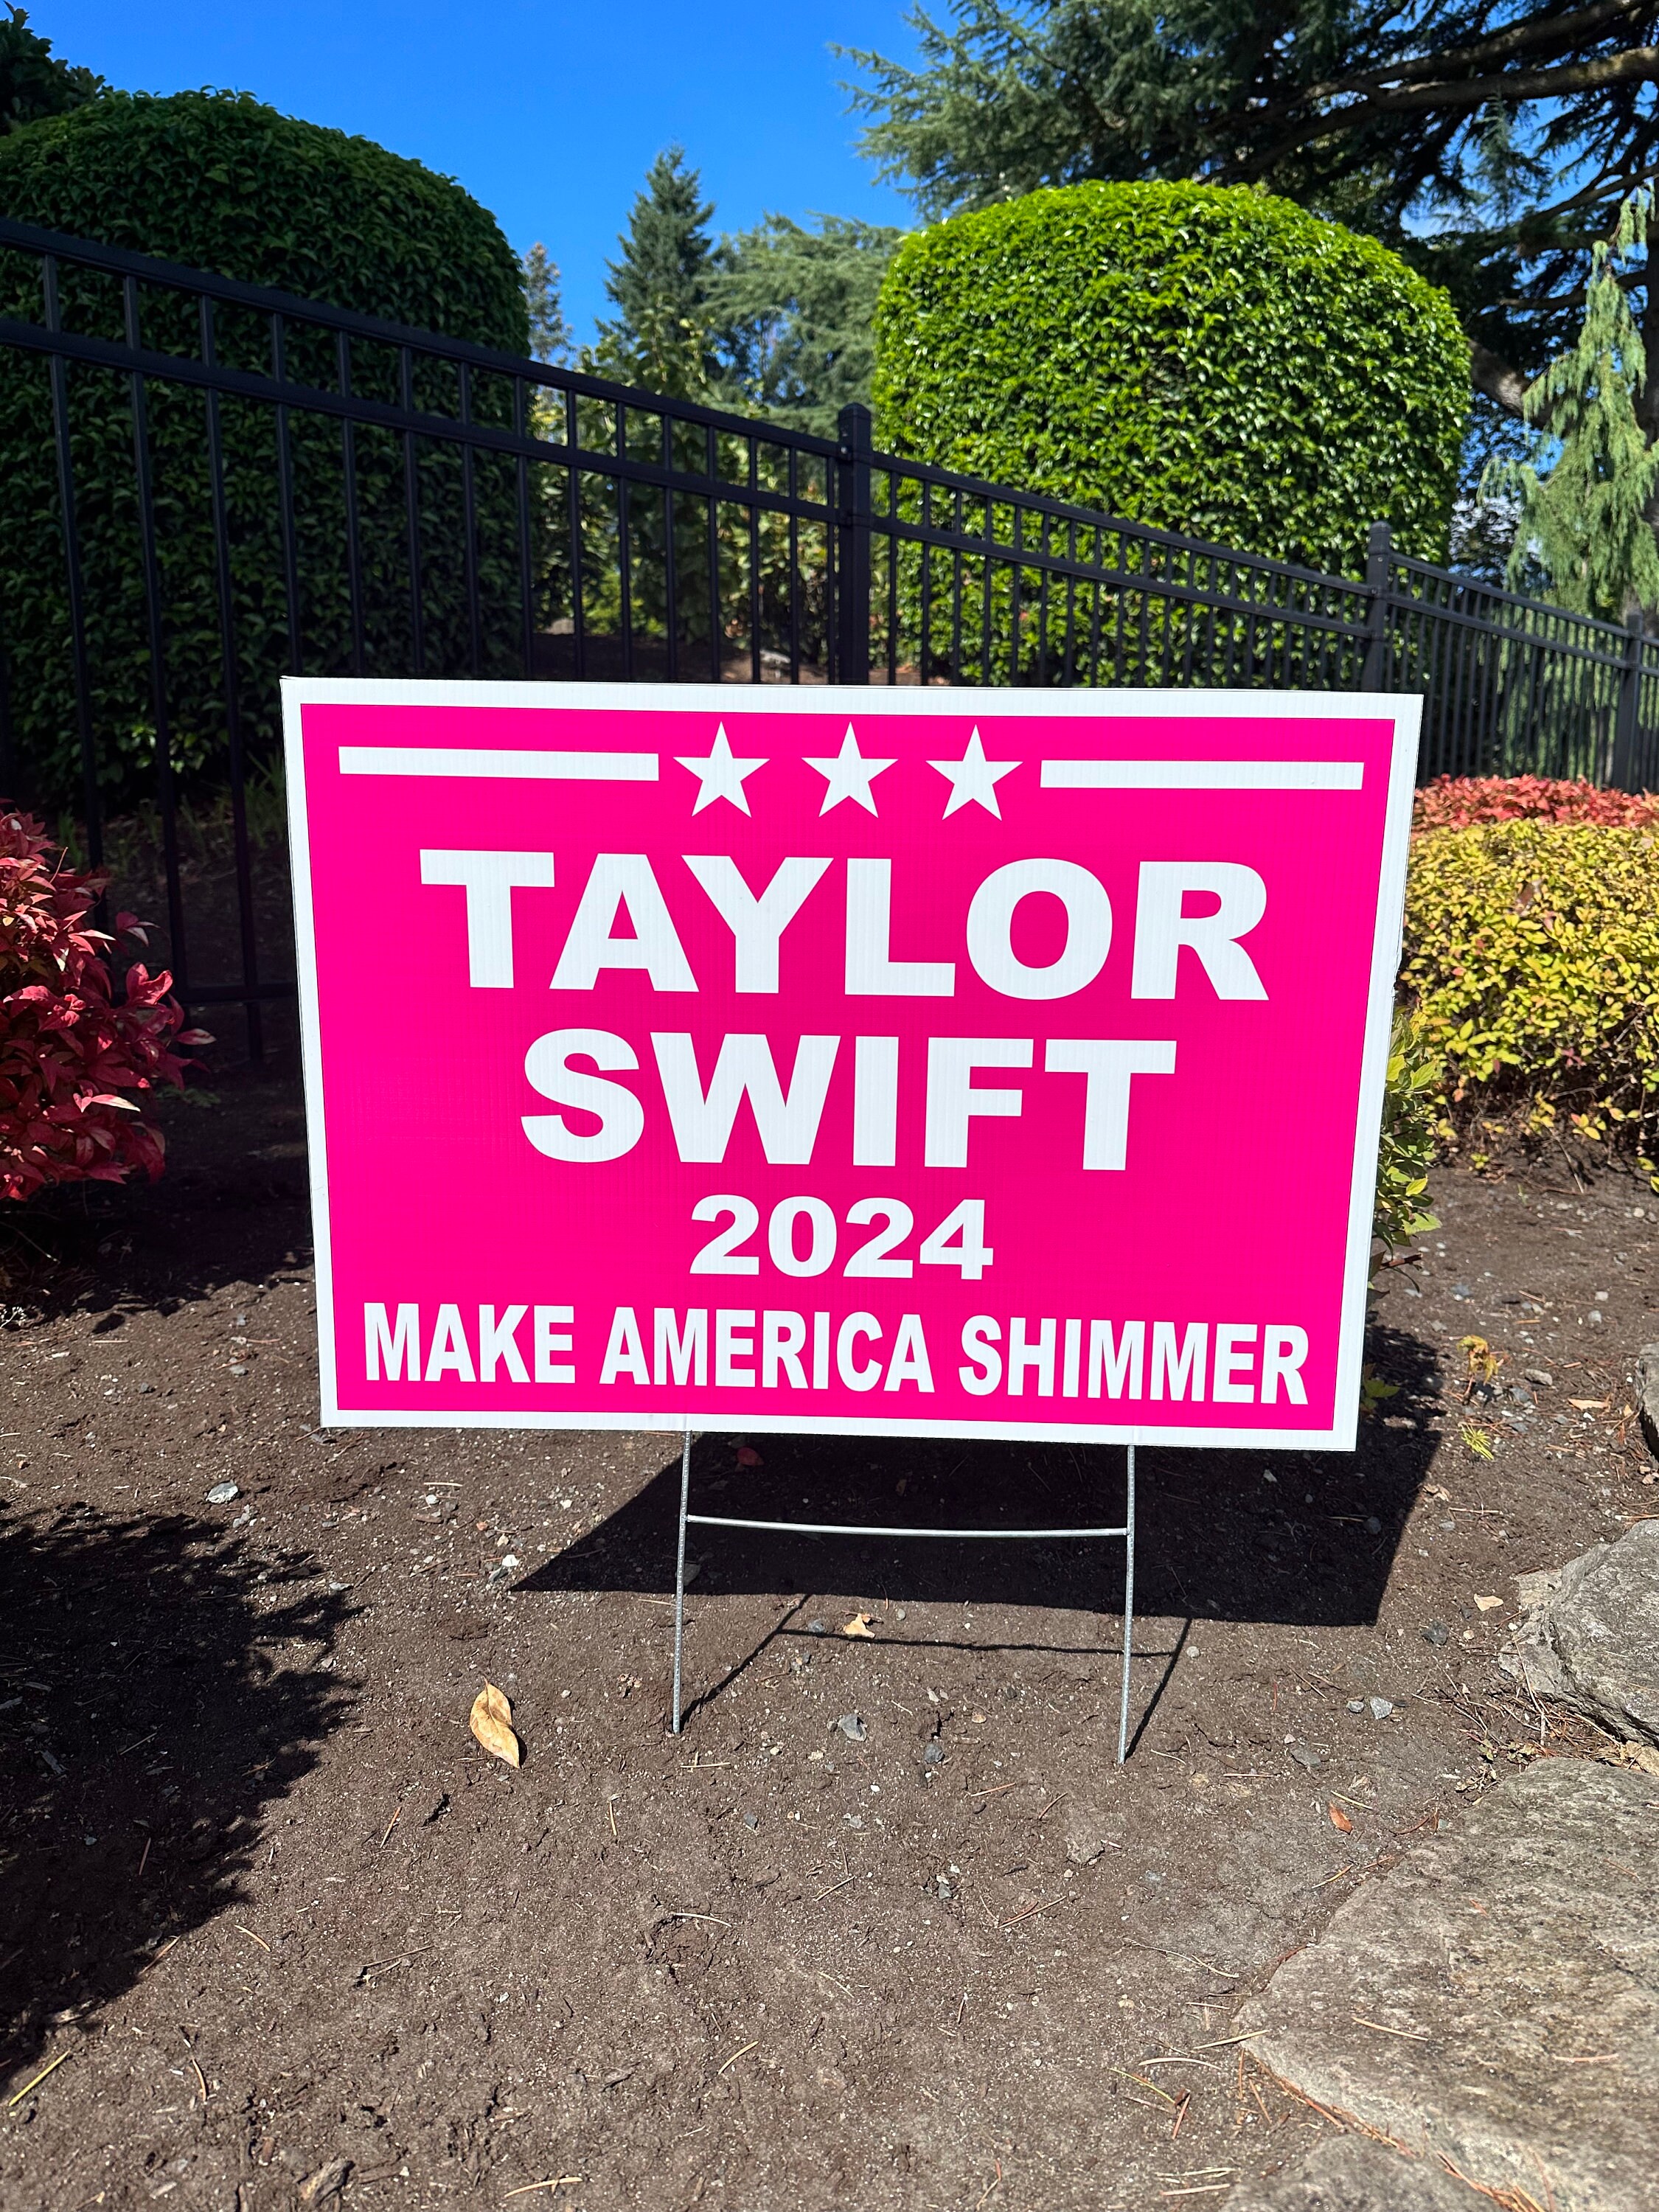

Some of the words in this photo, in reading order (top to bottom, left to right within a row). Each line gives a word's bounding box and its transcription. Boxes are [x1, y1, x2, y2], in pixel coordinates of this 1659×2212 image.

[420, 849, 1269, 1001] TAYLOR
[521, 1029, 1176, 1171] SWIFT
[690, 1194, 993, 1280] 2024
[364, 1303, 575, 1384] MAKE
[599, 1307, 934, 1392] AMERICA
[959, 1315, 1308, 1405] SHIMMER
